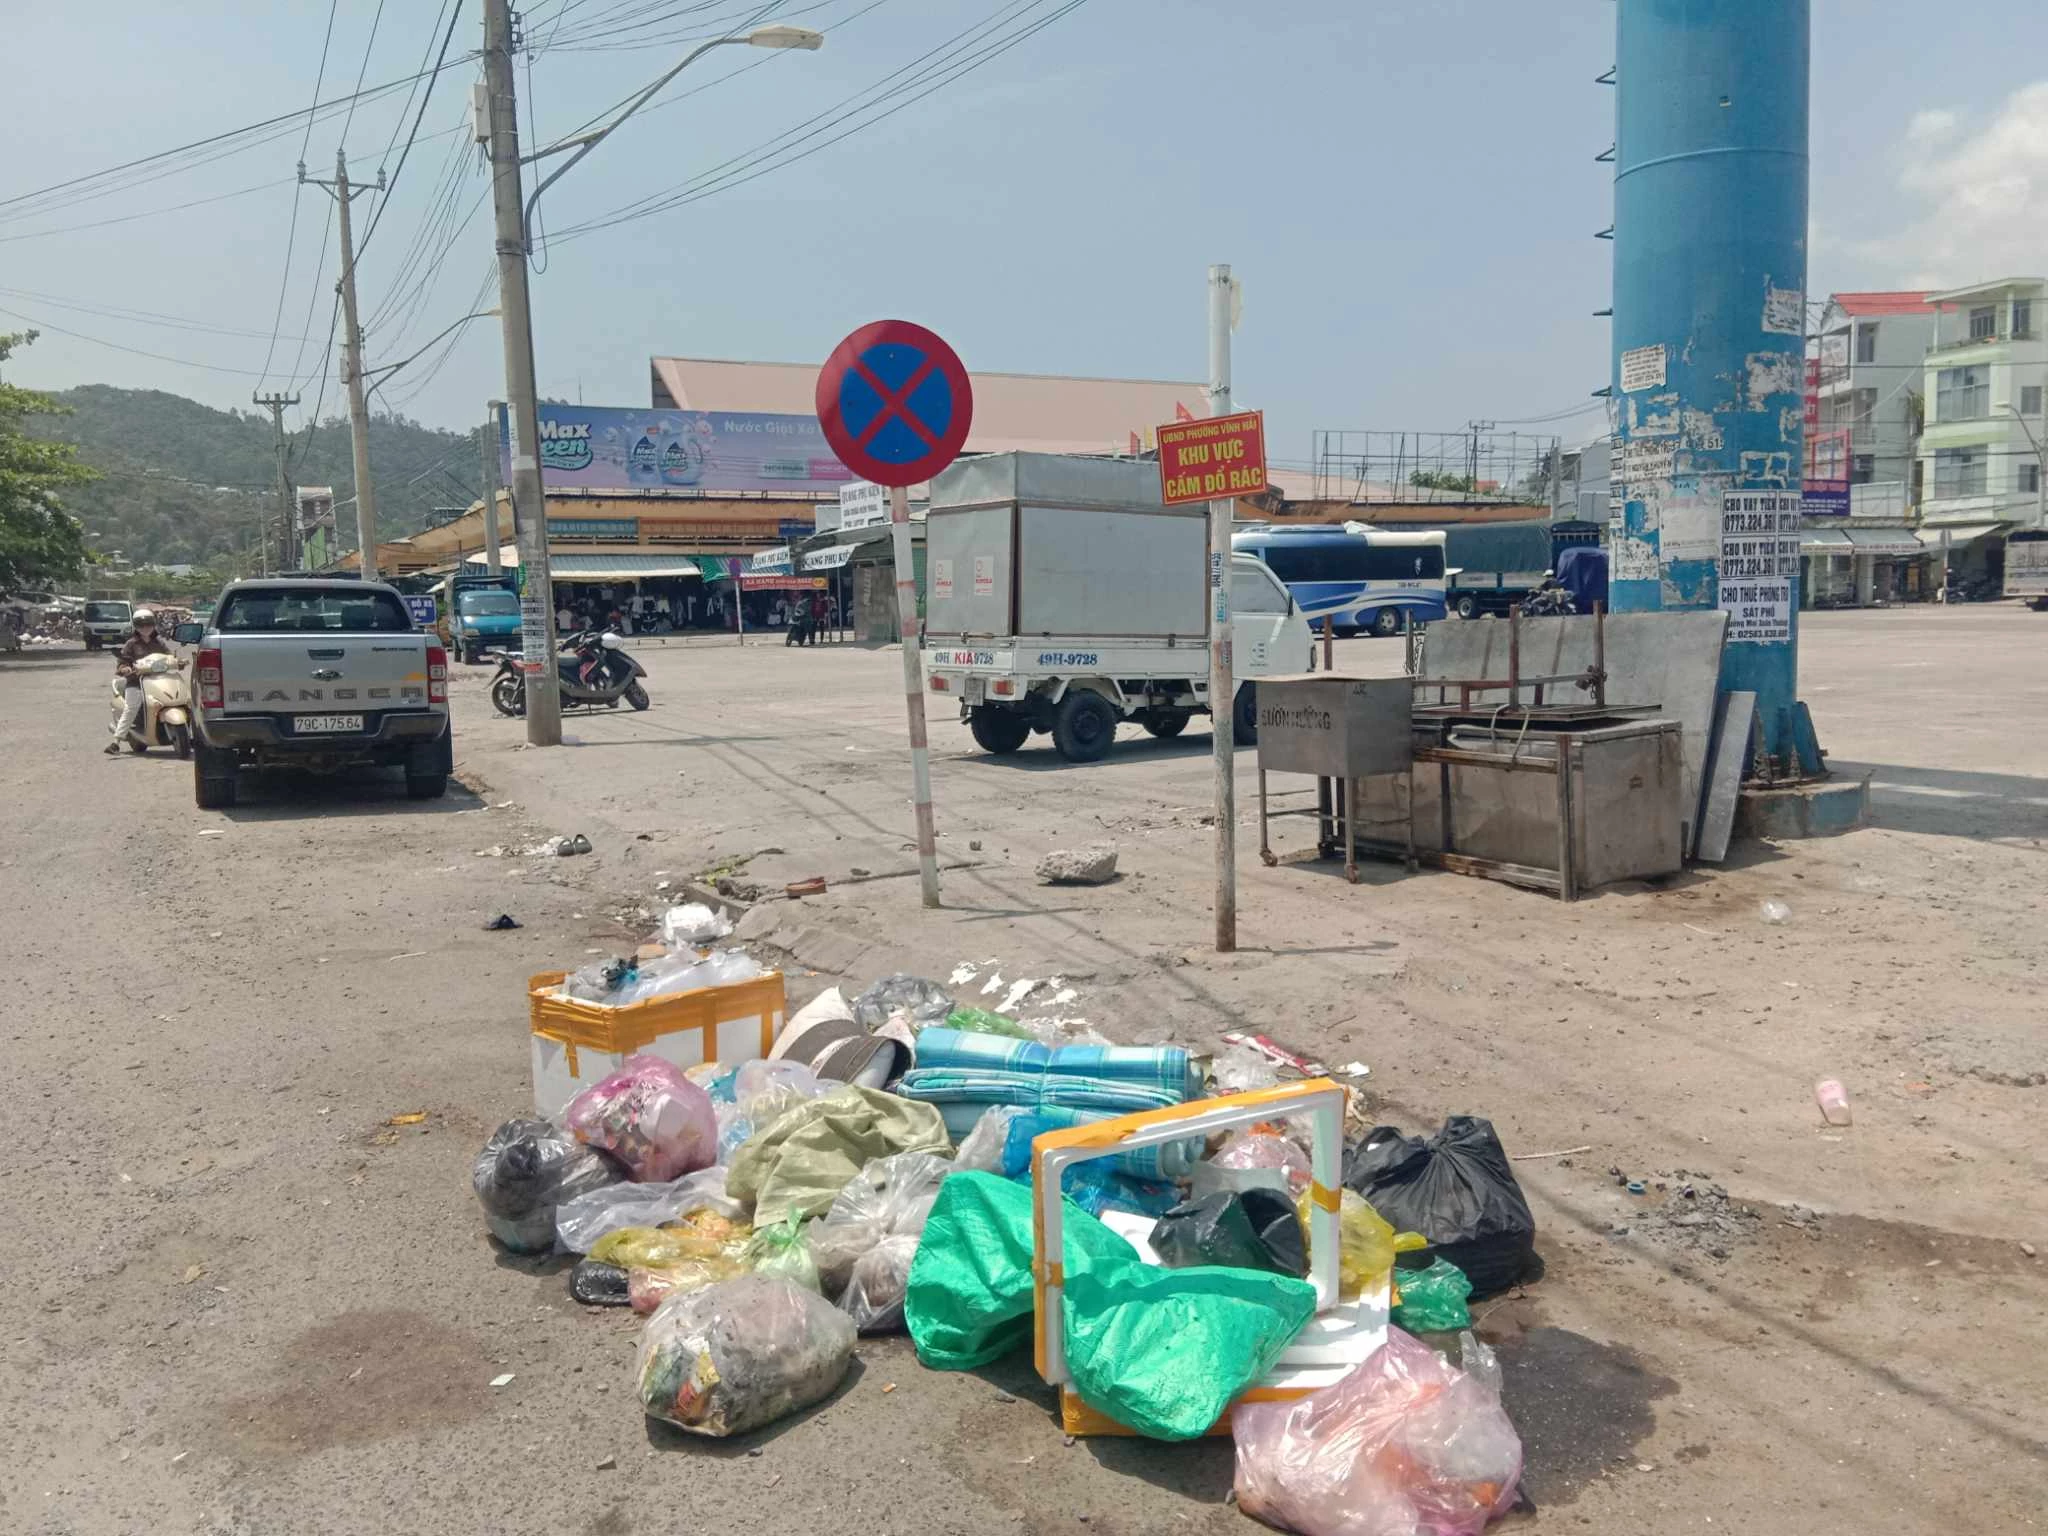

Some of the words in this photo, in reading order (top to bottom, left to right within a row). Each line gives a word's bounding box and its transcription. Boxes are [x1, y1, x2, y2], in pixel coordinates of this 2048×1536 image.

[538, 420, 591, 439] Max
[724, 420, 762, 433] Nước
[1178, 443, 1209, 466] KHU
[1213, 439, 1244, 464] VỰC
[1166, 471, 1200, 497] CẤM
[1204, 465, 1226, 492] ĐỔ
[1230, 465, 1261, 489] RÁC
[1724, 498, 1741, 511] CHO
[1743, 498, 1757, 511] VAY
[1722, 543, 1740, 556] CHO
[1742, 543, 1756, 555] VAY
[1721, 587, 1738, 602] CHO
[1740, 583, 1758, 602] THUÊ
[1743, 606, 1759, 618] SÁT
[954, 652, 974, 665] KIA
[974, 652, 994, 665] 9728
[1038, 653, 1098, 666] 49H-9728
[228, 687, 424, 702] RANGER
